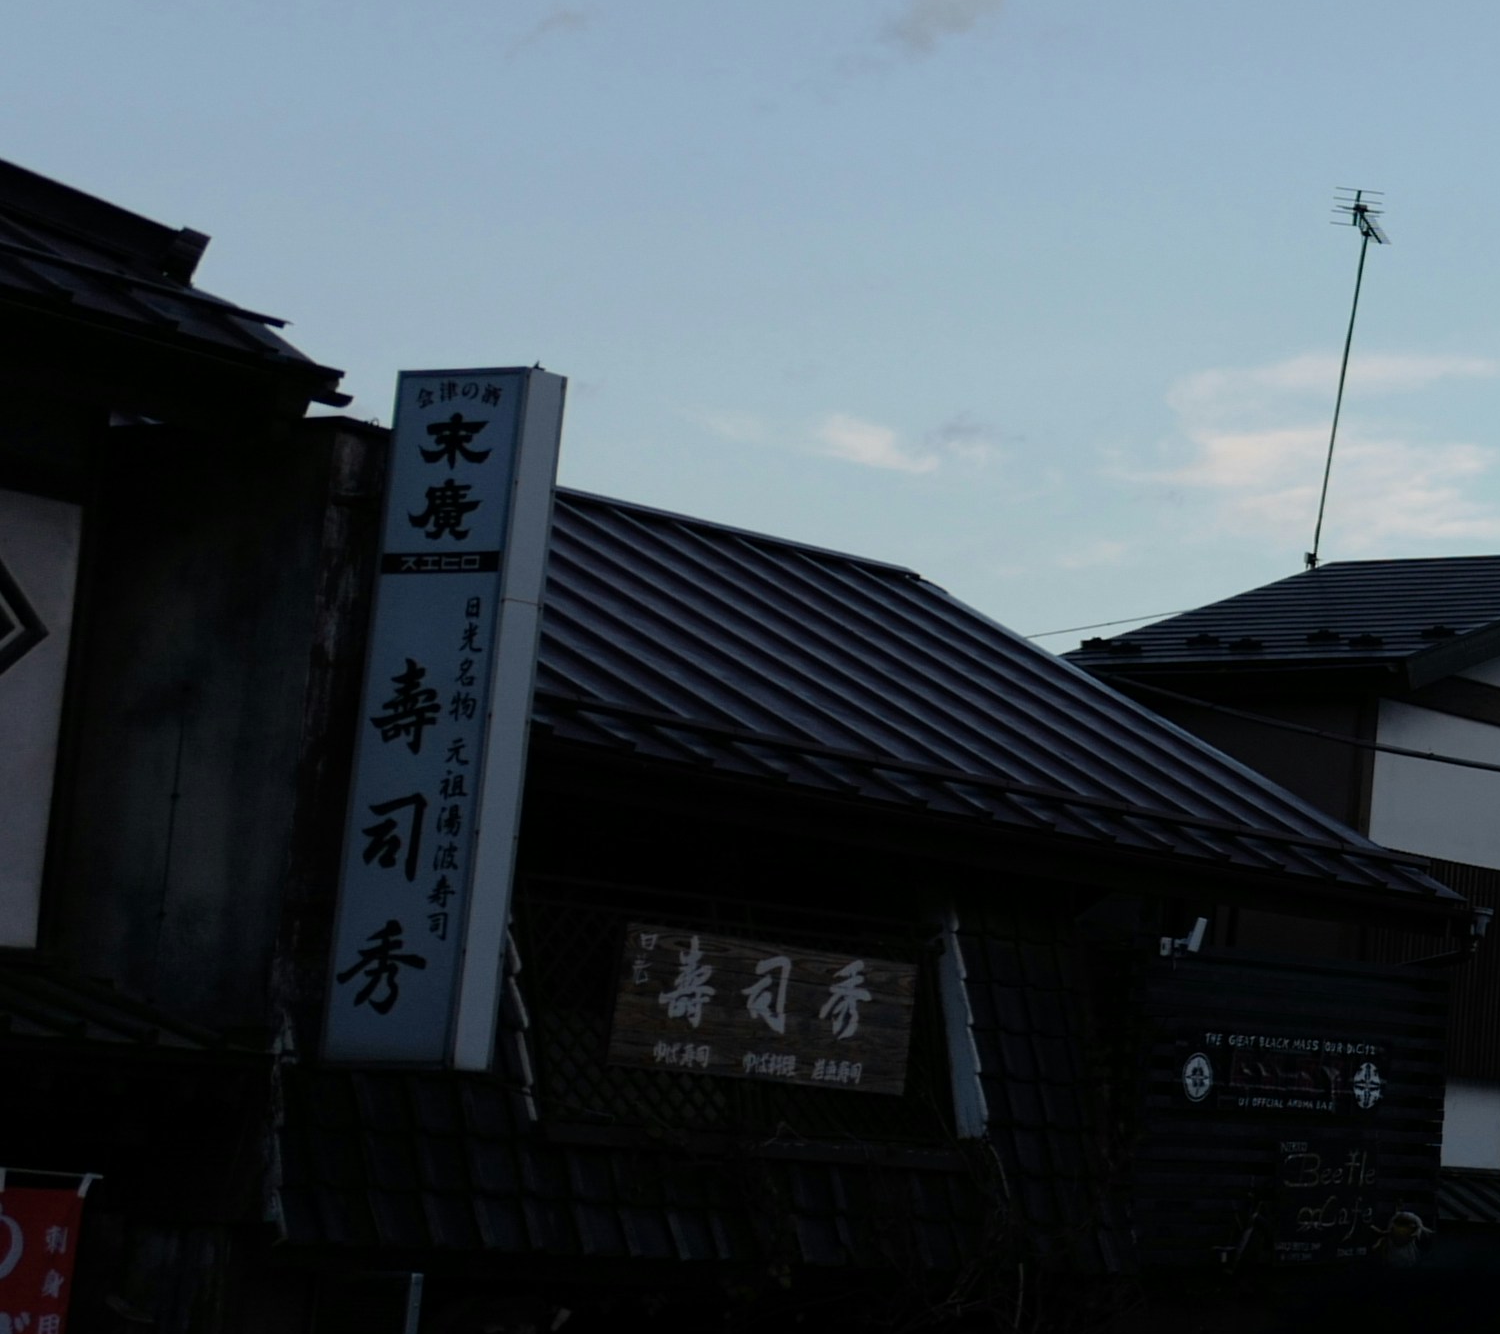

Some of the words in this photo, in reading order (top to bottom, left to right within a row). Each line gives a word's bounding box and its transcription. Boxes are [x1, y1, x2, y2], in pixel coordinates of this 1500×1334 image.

[408, 412, 493, 541] 末廣
[401, 555, 481, 571] スエヒロ
[449, 597, 482, 722] 日光名物
[1285, 1145, 1376, 1188] Beetle
